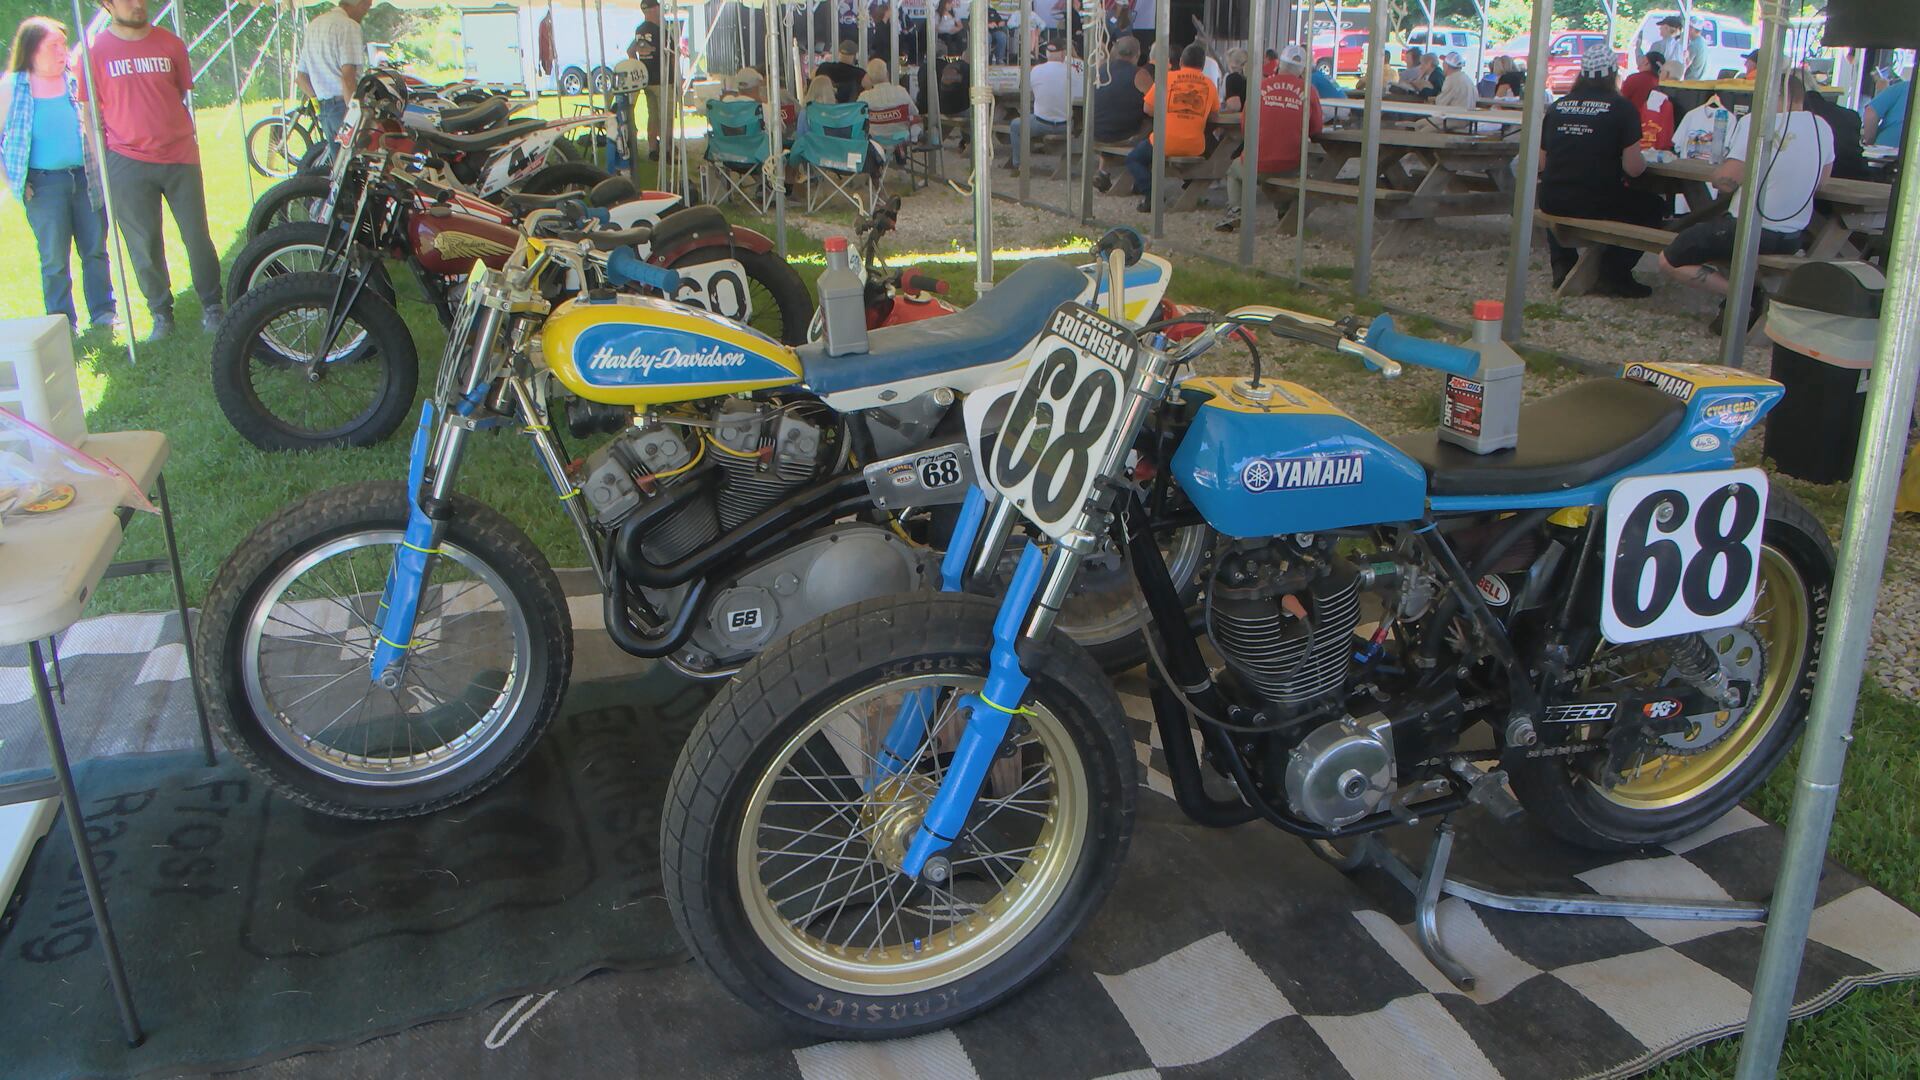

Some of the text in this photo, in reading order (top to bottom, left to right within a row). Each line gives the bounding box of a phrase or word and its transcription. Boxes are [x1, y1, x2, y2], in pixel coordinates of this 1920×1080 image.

[108, 57, 171, 77] LIVE UNITED
[1582, 101, 1611, 109] STREET
[1075, 308, 1124, 338] TROY
[1052, 310, 1134, 372] ERICHSEN
[590, 345, 746, 377] Harley-Davidson
[1448, 376, 1483, 393] AMSOIL
[1643, 369, 1694, 400] YAMAHA
[1443, 394, 1453, 427] DIRT
[1706, 400, 1756, 417] CYCLE GEAR
[1719, 413, 1751, 427] Racing
[996, 347, 1117, 524] 68
[922, 459, 960, 488] 68
[1275, 457, 1363, 488] YAMAHA
[1612, 482, 1760, 628] 68
[1477, 576, 1501, 600] BELL
[732, 610, 758, 628] 68
